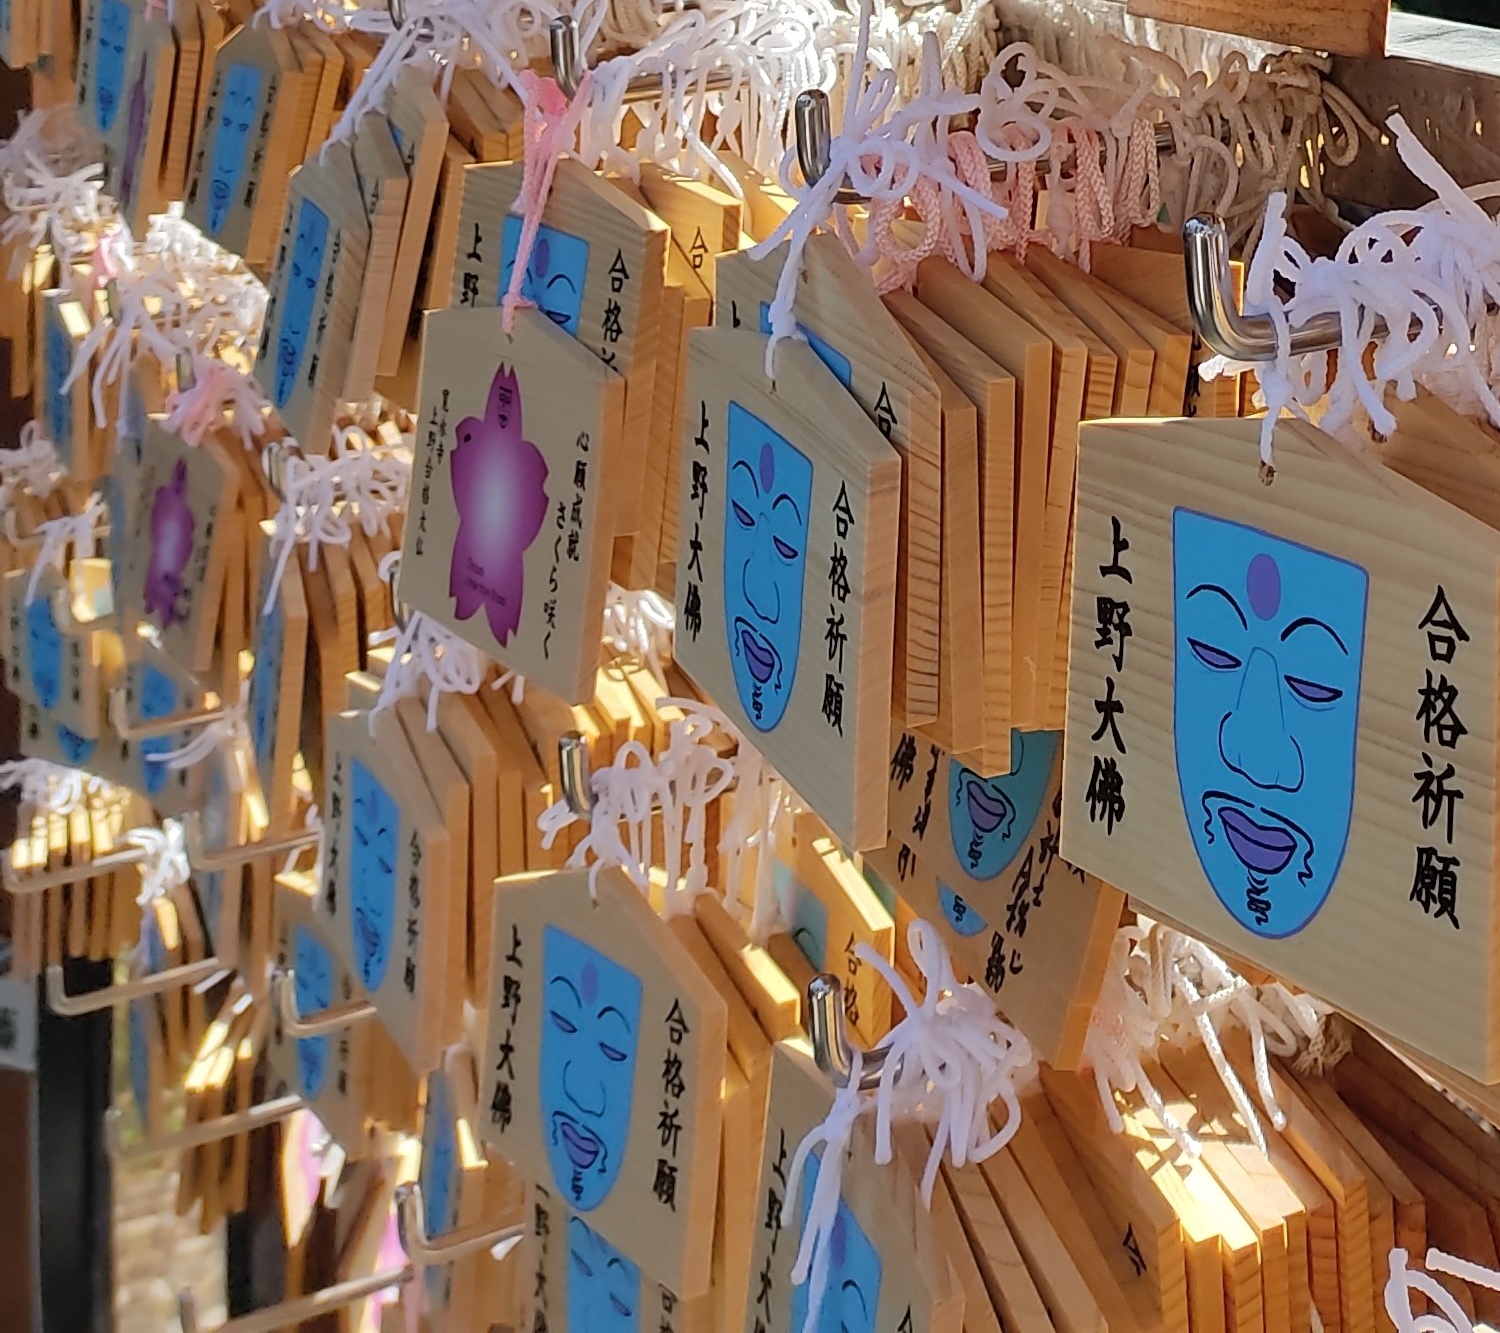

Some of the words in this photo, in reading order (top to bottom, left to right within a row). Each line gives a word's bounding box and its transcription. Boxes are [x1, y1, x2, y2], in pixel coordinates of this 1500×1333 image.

[684, 402, 711, 642] 上野大佛
[821, 482, 854, 737] 合格祈願
[1085, 516, 1133, 836] 上野大佛
[1409, 585, 1470, 929] 合格祈願
[490, 924, 524, 1133] 上野大佛
[653, 997, 689, 1213] 合格祈願
